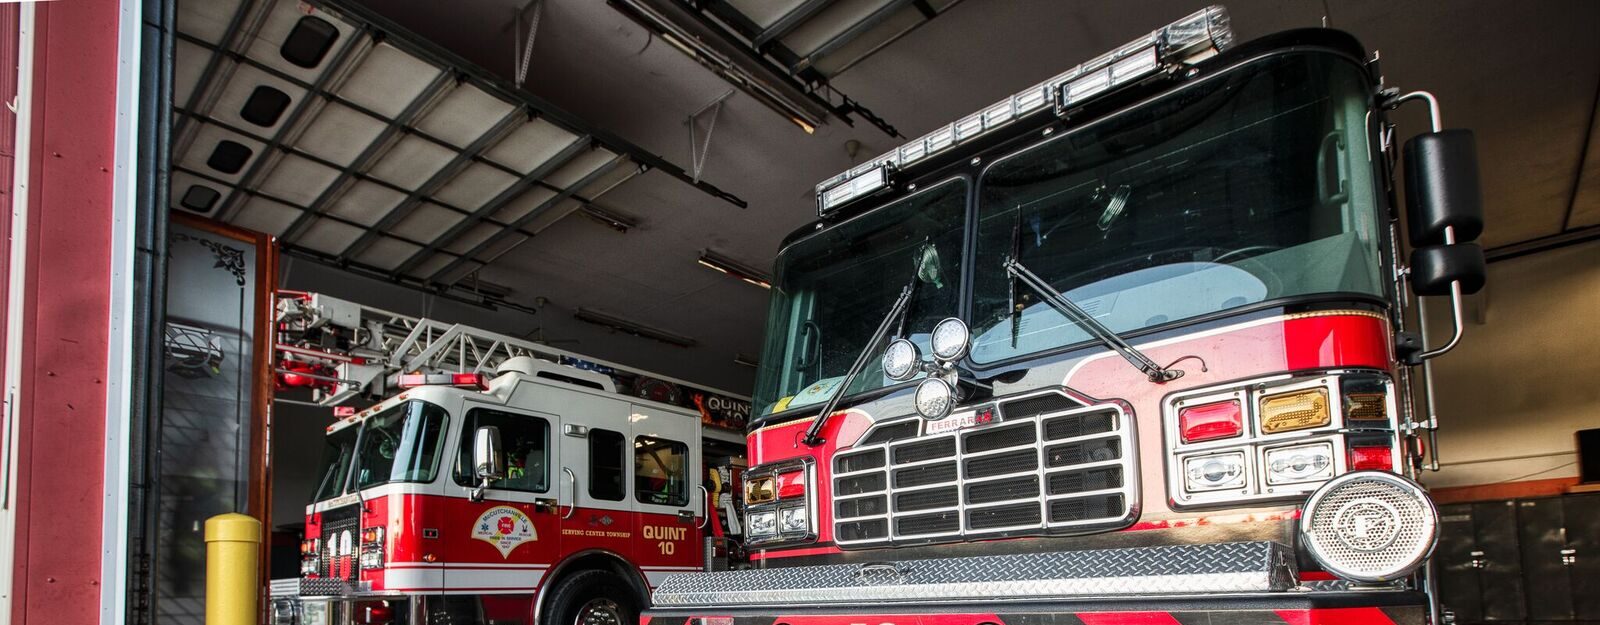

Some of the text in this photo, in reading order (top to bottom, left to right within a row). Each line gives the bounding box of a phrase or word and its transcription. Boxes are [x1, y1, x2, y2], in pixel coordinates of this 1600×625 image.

[708, 397, 752, 416] QUIN
[561, 528, 585, 536] SERVING
[585, 529, 606, 537] CENTER
[643, 525, 687, 541] QUINT
[327, 529, 352, 582] 10
[657, 541, 675, 555] 10
